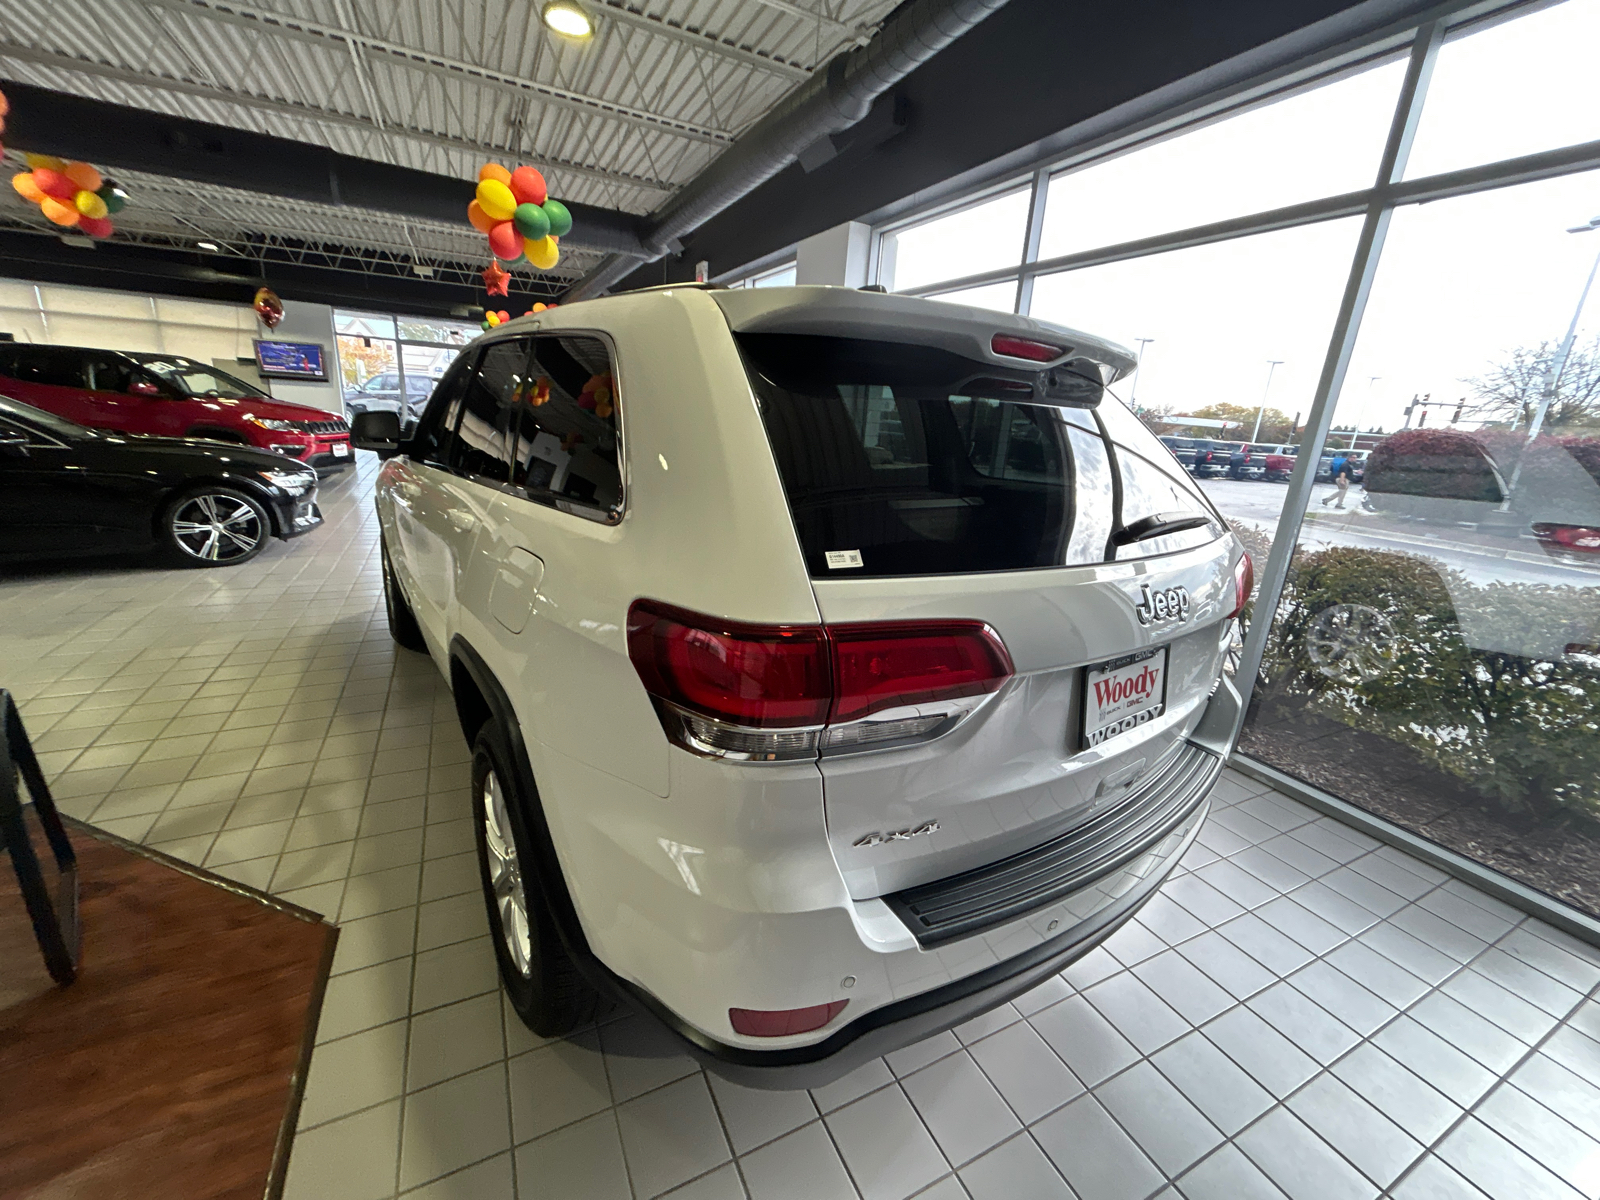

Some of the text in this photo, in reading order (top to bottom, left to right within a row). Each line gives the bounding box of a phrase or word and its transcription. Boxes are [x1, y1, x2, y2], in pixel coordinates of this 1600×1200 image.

[1136, 583, 1190, 625] Jeep
[1135, 650, 1155, 661] GMC
[1093, 665, 1160, 709] Woody
[1106, 697, 1143, 715] BUICK GMC
[1088, 706, 1160, 748] WOODY
